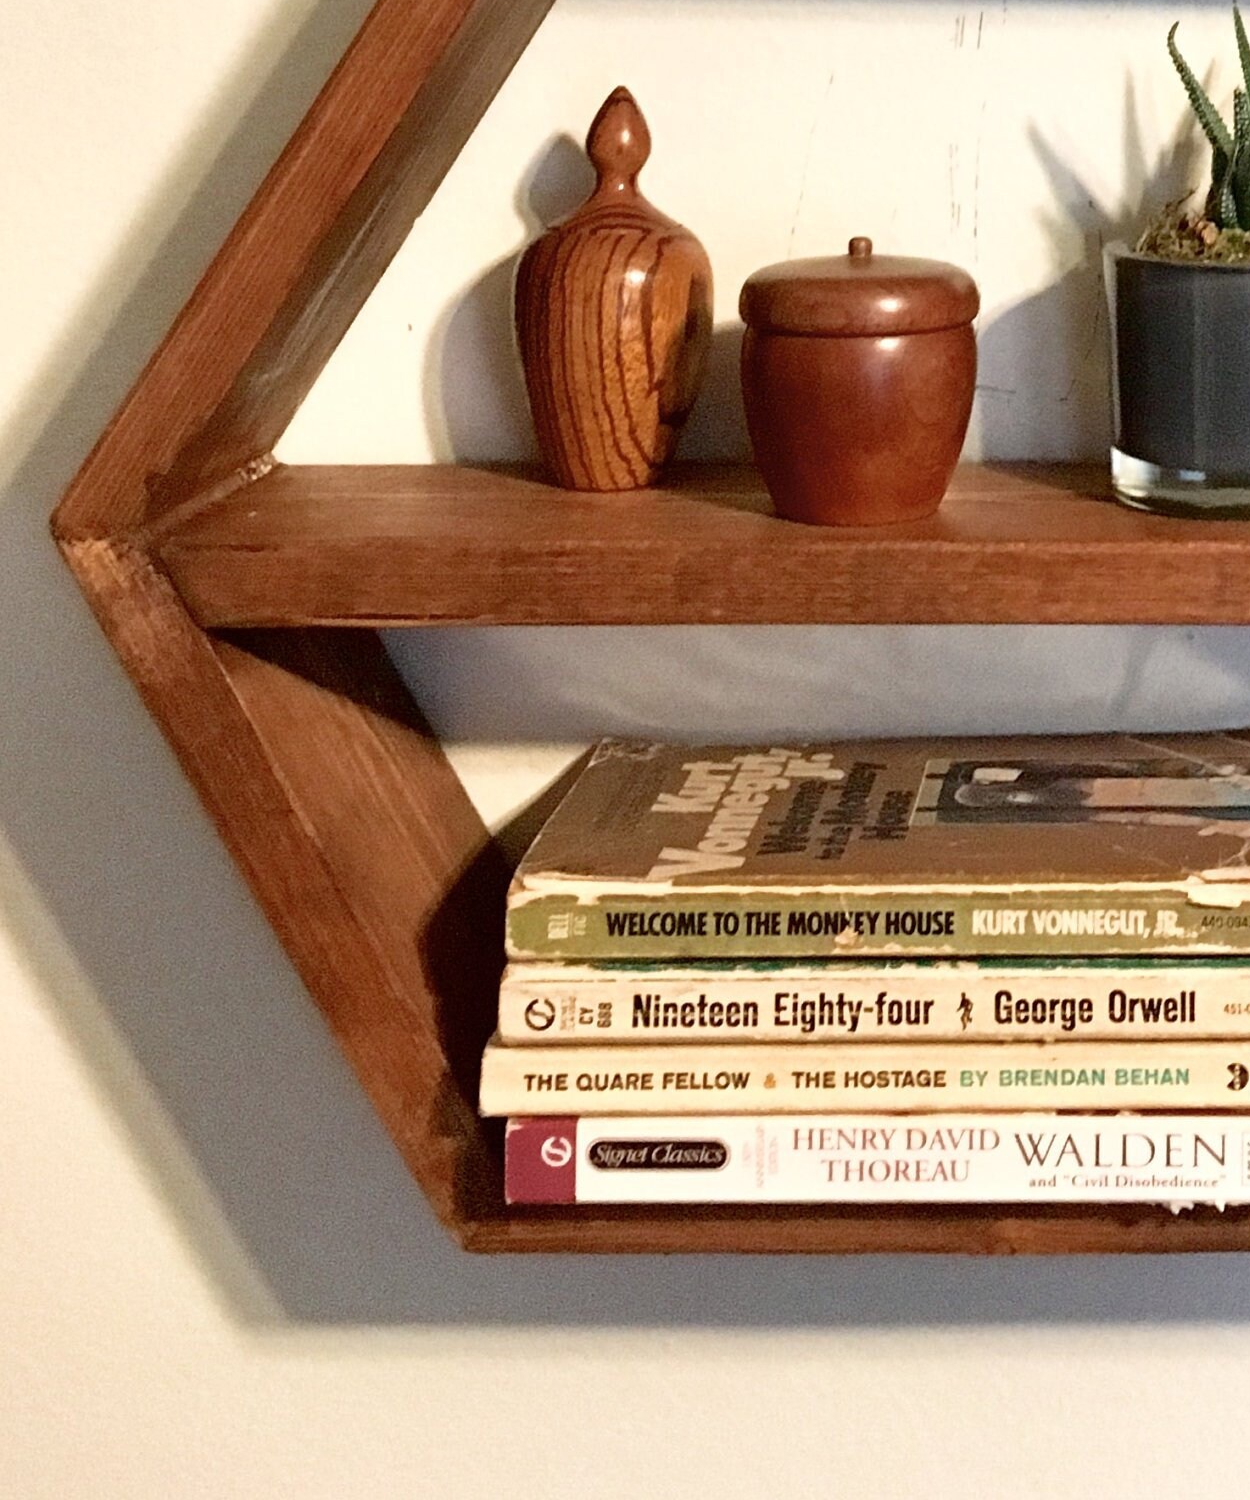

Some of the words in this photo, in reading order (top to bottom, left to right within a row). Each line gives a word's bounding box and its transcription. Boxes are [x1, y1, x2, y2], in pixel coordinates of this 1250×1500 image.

[651, 761, 738, 812] Kurt
[606, 911, 706, 937] WELCOME
[713, 911, 739, 936] TO
[746, 911, 781, 936] THE
[787, 910, 880, 937] MONKEY
[885, 910, 955, 936] HOUSE
[972, 909, 1028, 936] KURT
[1033, 909, 1150, 939] VONNEGUT,
[578, 1007, 593, 1025] CY
[632, 994, 759, 1028] Nineteen
[774, 991, 935, 1033] Eighty-four
[994, 989, 1094, 1031] George
[1108, 989, 1196, 1024] Orwell
[524, 1073, 569, 1091] THE
[576, 1072, 654, 1091] QUARE
[662, 1071, 751, 1090] FELLOW
[763, 1073, 777, 1089] &
[791, 1070, 836, 1088] THE
[844, 1069, 948, 1088] HOSTAGE
[959, 1070, 988, 1087] BY
[999, 1069, 1106, 1087] BRENDAN
[1114, 1068, 1190, 1086] BEHAN
[793, 1128, 896, 1151] HENRY
[906, 1128, 1000, 1151] DAVID
[1014, 1132, 1227, 1169] WALDEN
[595, 1142, 649, 1167] Signet
[651, 1141, 725, 1164] Classics
[821, 1158, 970, 1183] THOREAU
[1028, 1173, 1057, 1189] and
[1063, 1173, 1109, 1189] "Civil
[1115, 1173, 1227, 1189] Disobedience"
